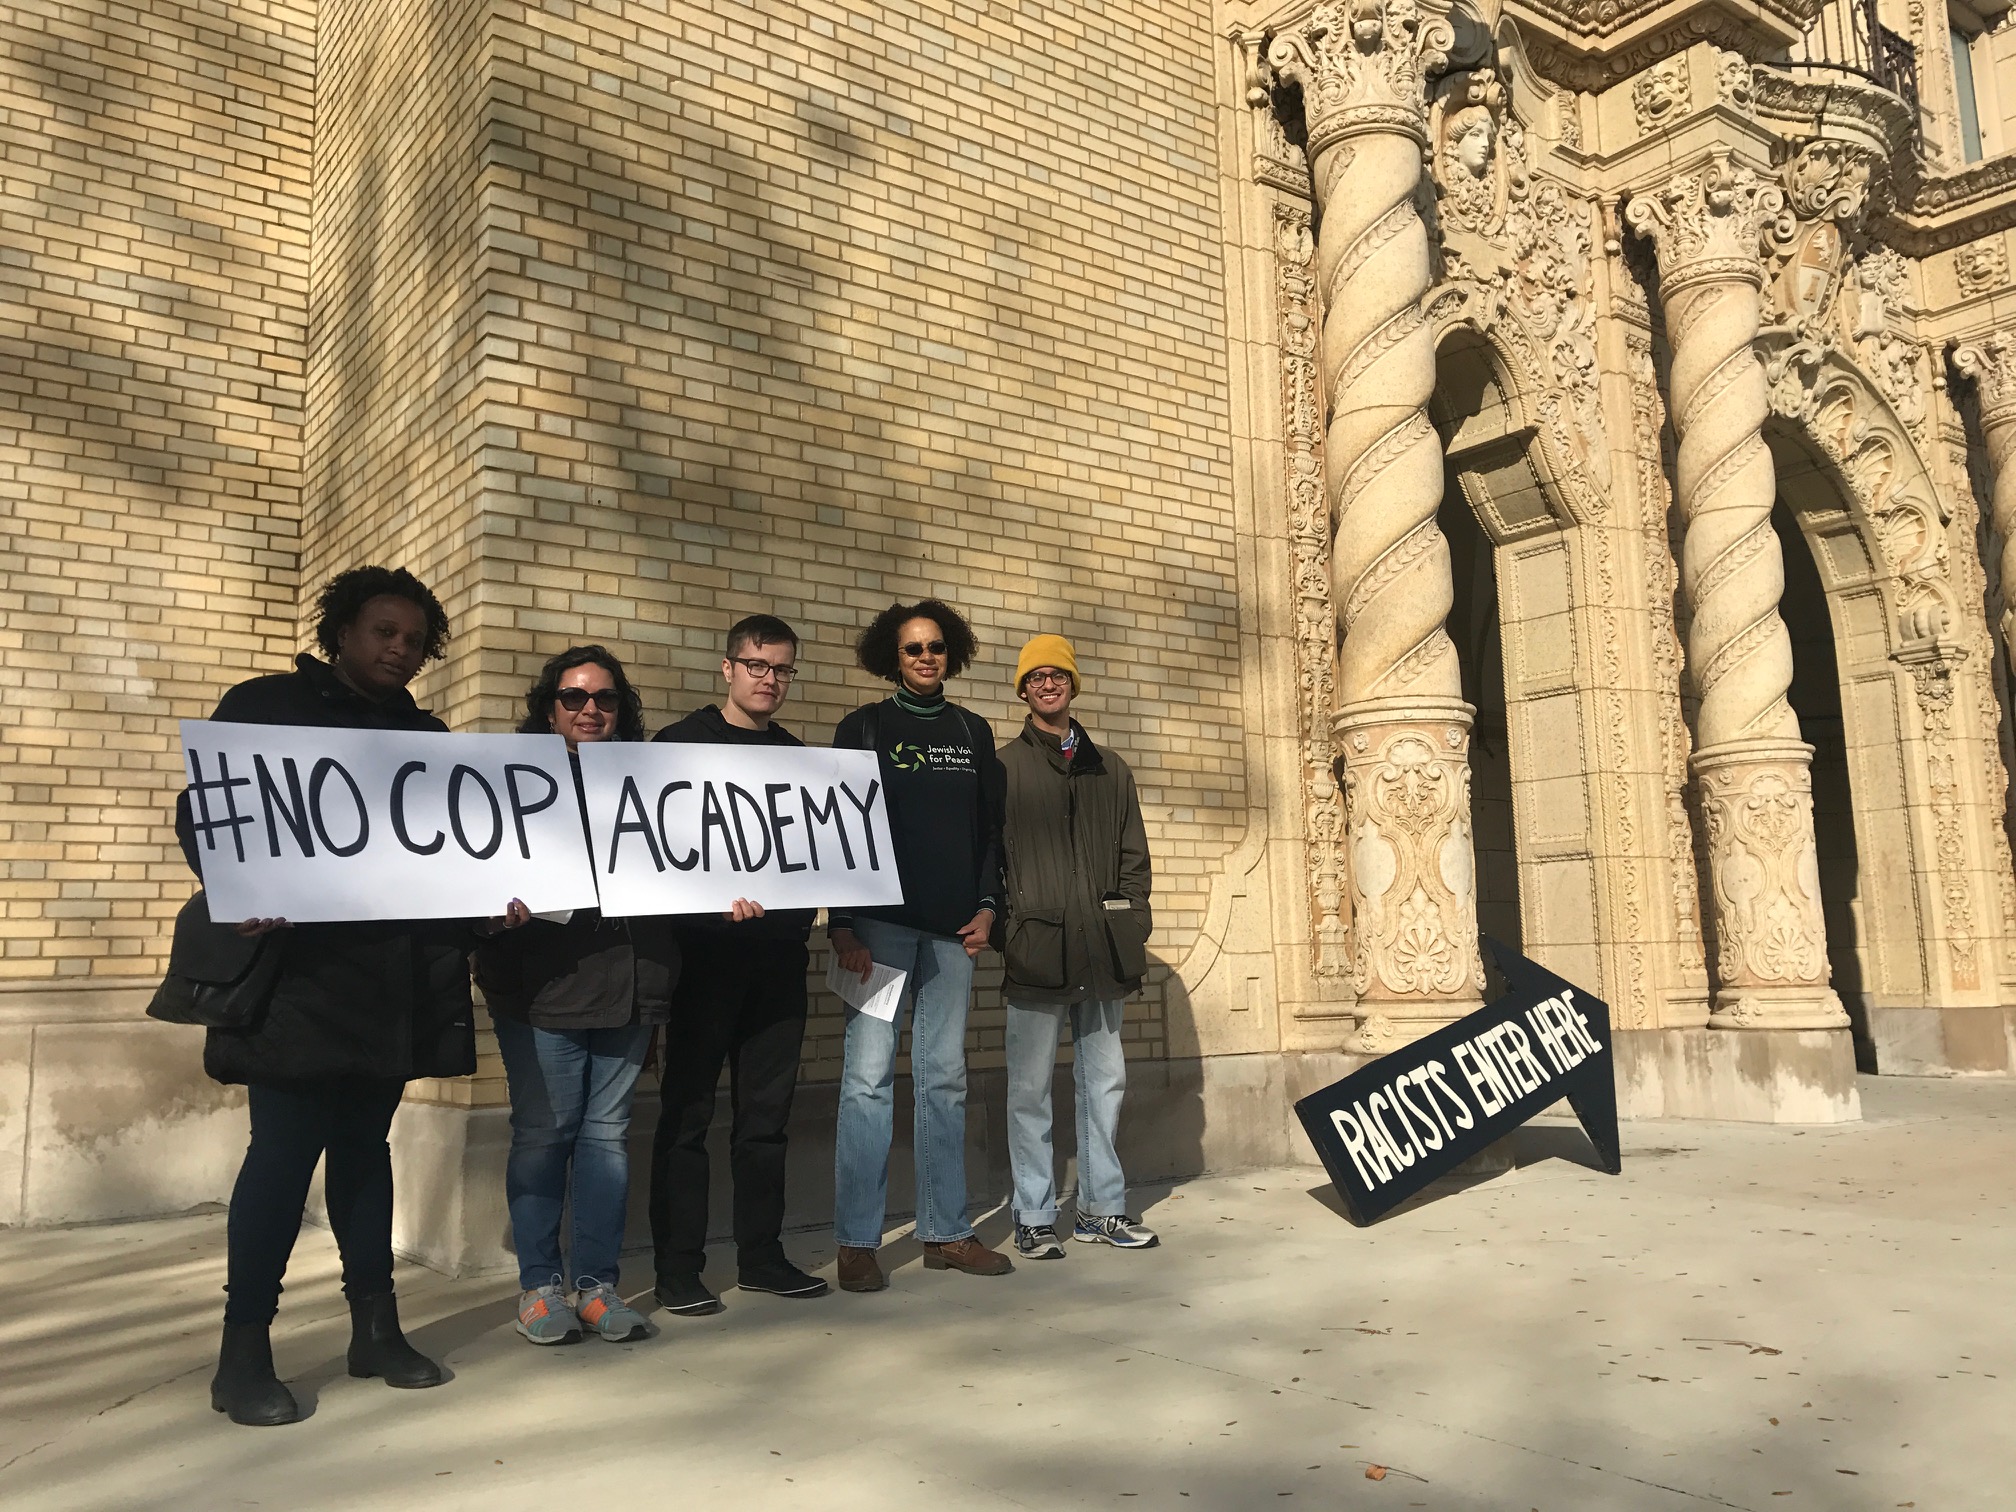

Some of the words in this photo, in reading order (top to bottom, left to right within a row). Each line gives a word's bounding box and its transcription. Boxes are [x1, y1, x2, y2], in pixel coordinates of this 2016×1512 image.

[927, 744, 956, 754] Jewish
[956, 745, 974, 755] Voi
[929, 754, 943, 763] for
[944, 754, 971, 764] Peace
[187, 748, 370, 862] #NO
[390, 760, 559, 861] COP
[609, 775, 880, 874] ACADEMY
[1329, 1059, 1475, 1192] RACISTS
[1450, 1020, 1552, 1118] ENTER
[1525, 988, 1603, 1075] HERE
